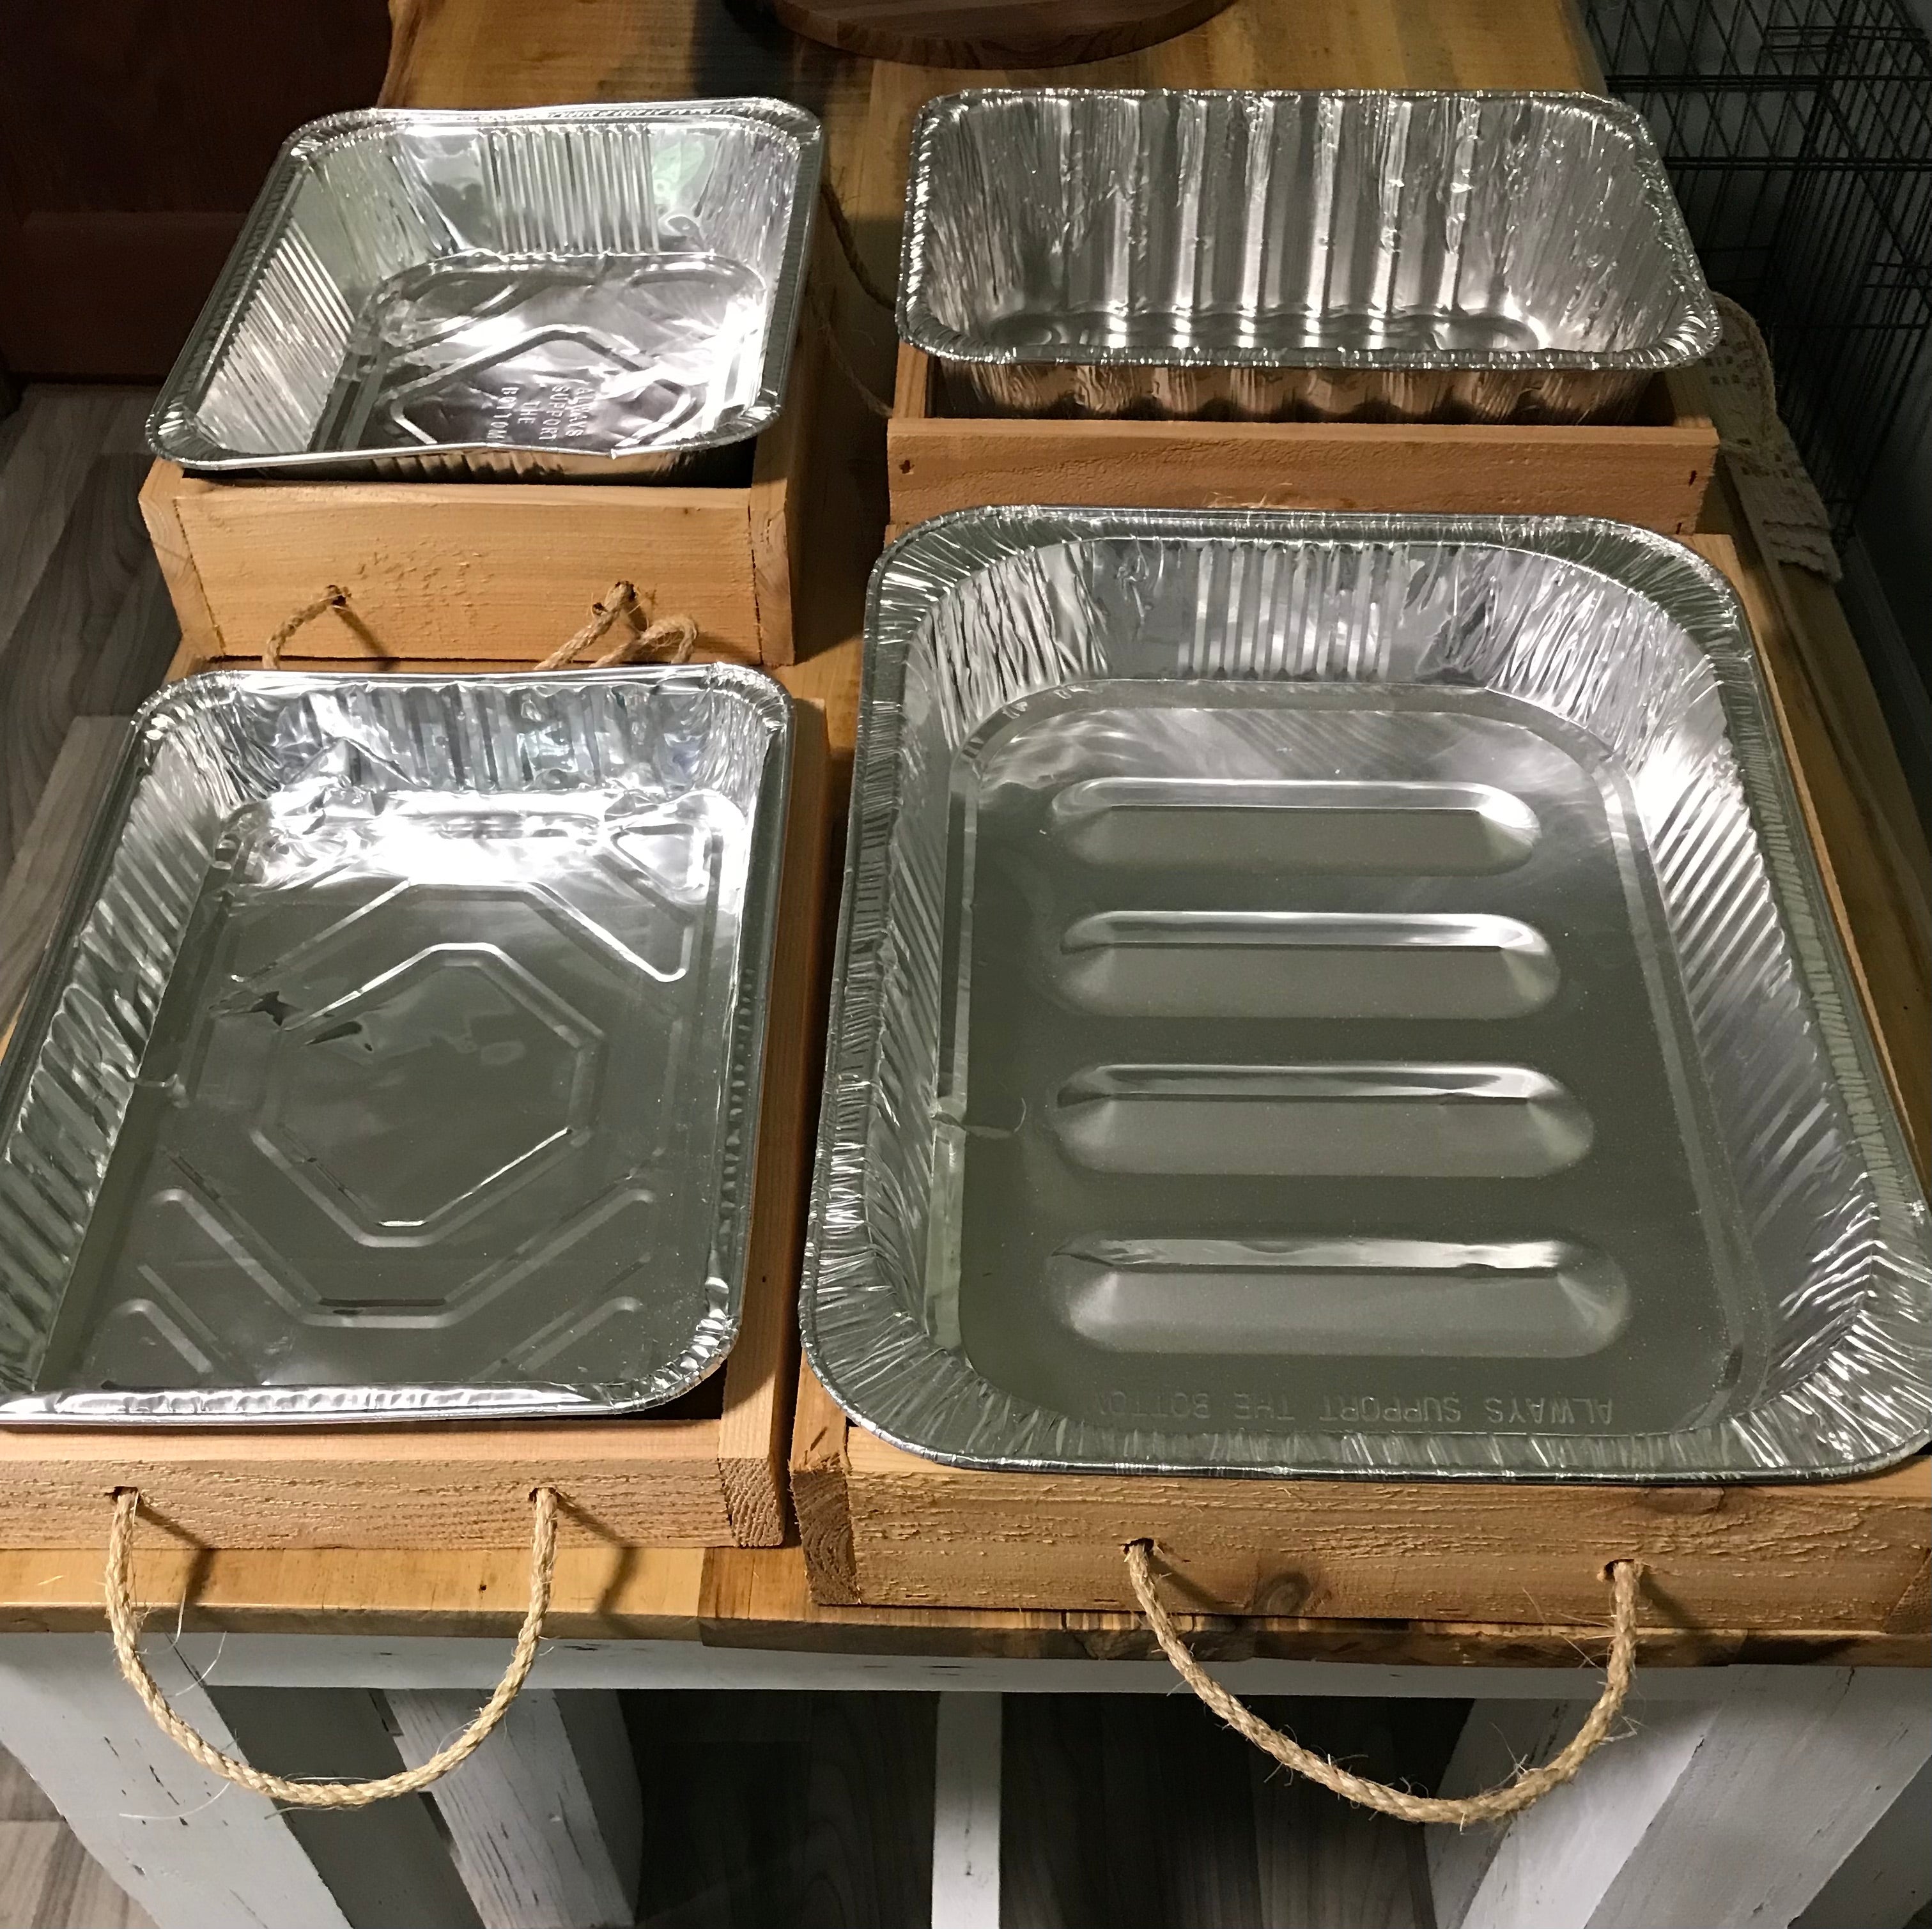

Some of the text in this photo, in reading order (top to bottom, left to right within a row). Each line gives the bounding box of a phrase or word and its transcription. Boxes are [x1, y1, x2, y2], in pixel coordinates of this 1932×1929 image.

[486, 386, 520, 440] BOTTOM
[517, 400, 541, 425] THE
[538, 385, 571, 441] SUPPORT
[1233, 1392, 1295, 1420] THE
[1319, 1394, 1462, 1423] SUPPORT
[1484, 1397, 1612, 1425] ALWAYS
